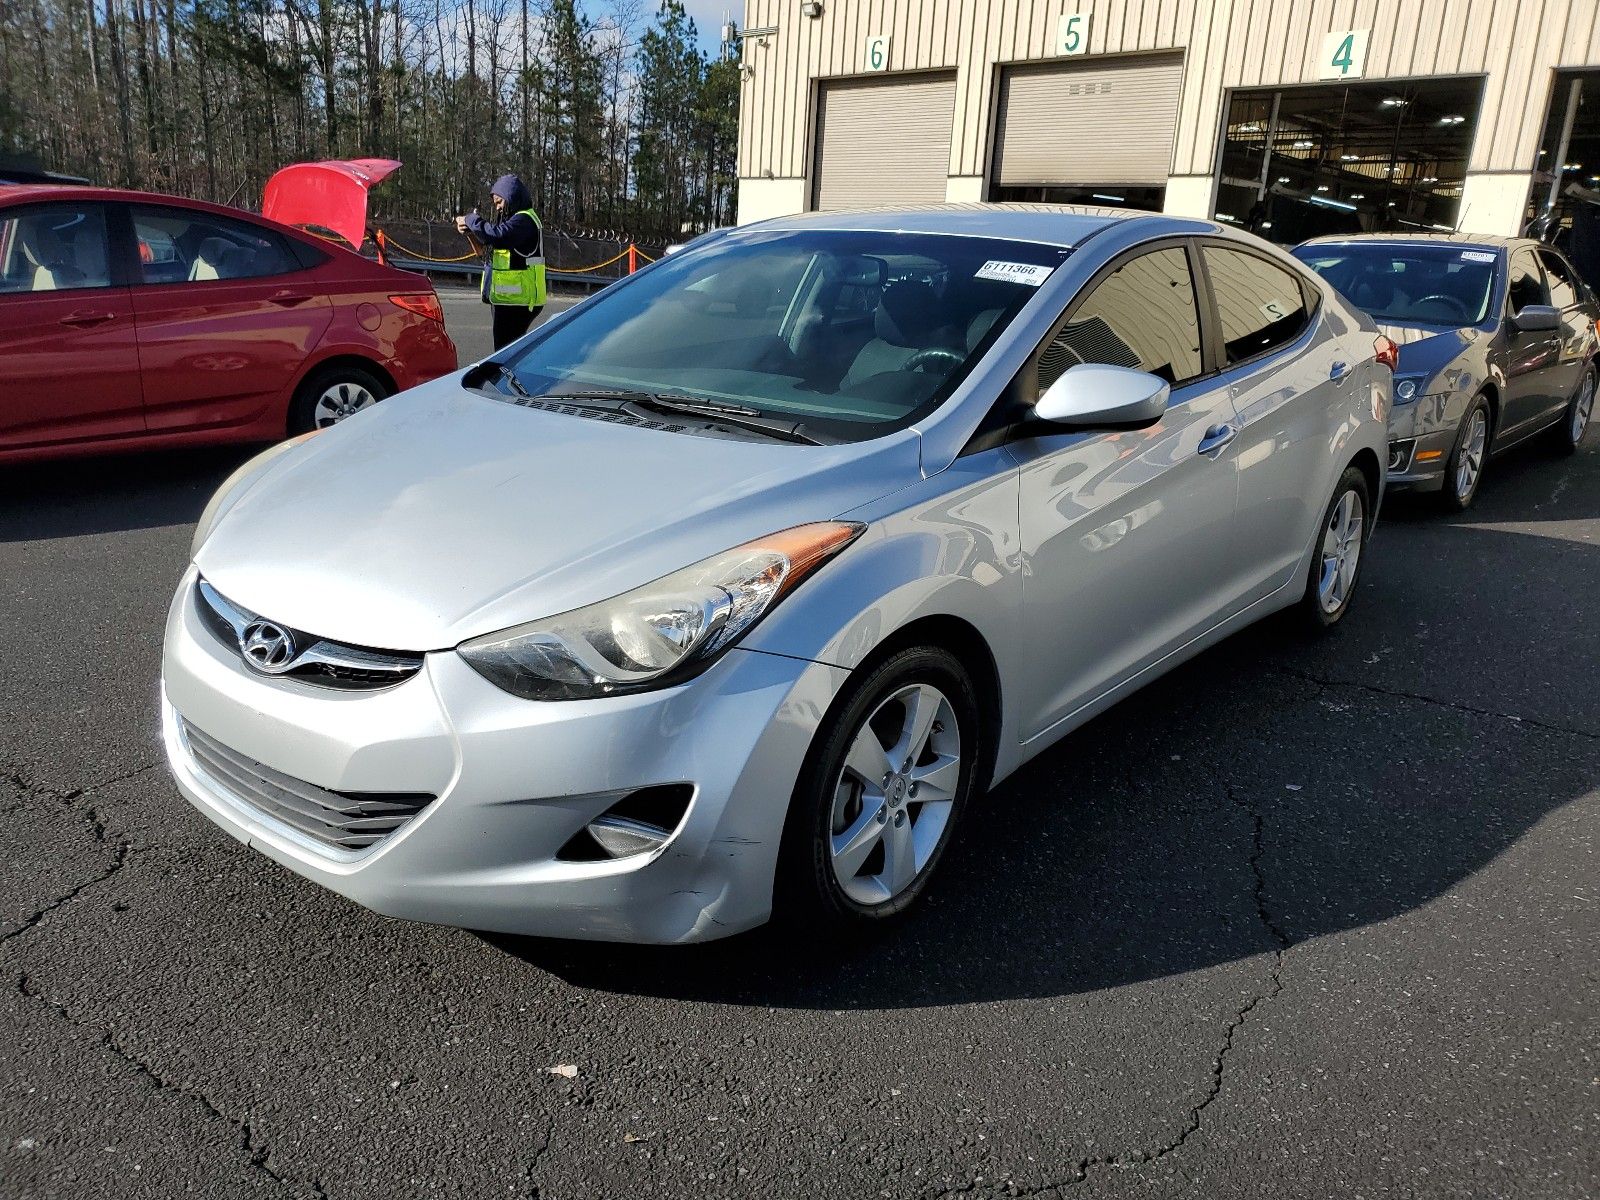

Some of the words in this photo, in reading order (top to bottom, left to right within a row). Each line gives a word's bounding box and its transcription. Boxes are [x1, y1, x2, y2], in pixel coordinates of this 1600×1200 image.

[1065, 17, 1081, 52] 5
[870, 40, 883, 70] 6
[1331, 34, 1354, 74] 4
[984, 262, 1038, 275] 6111366
